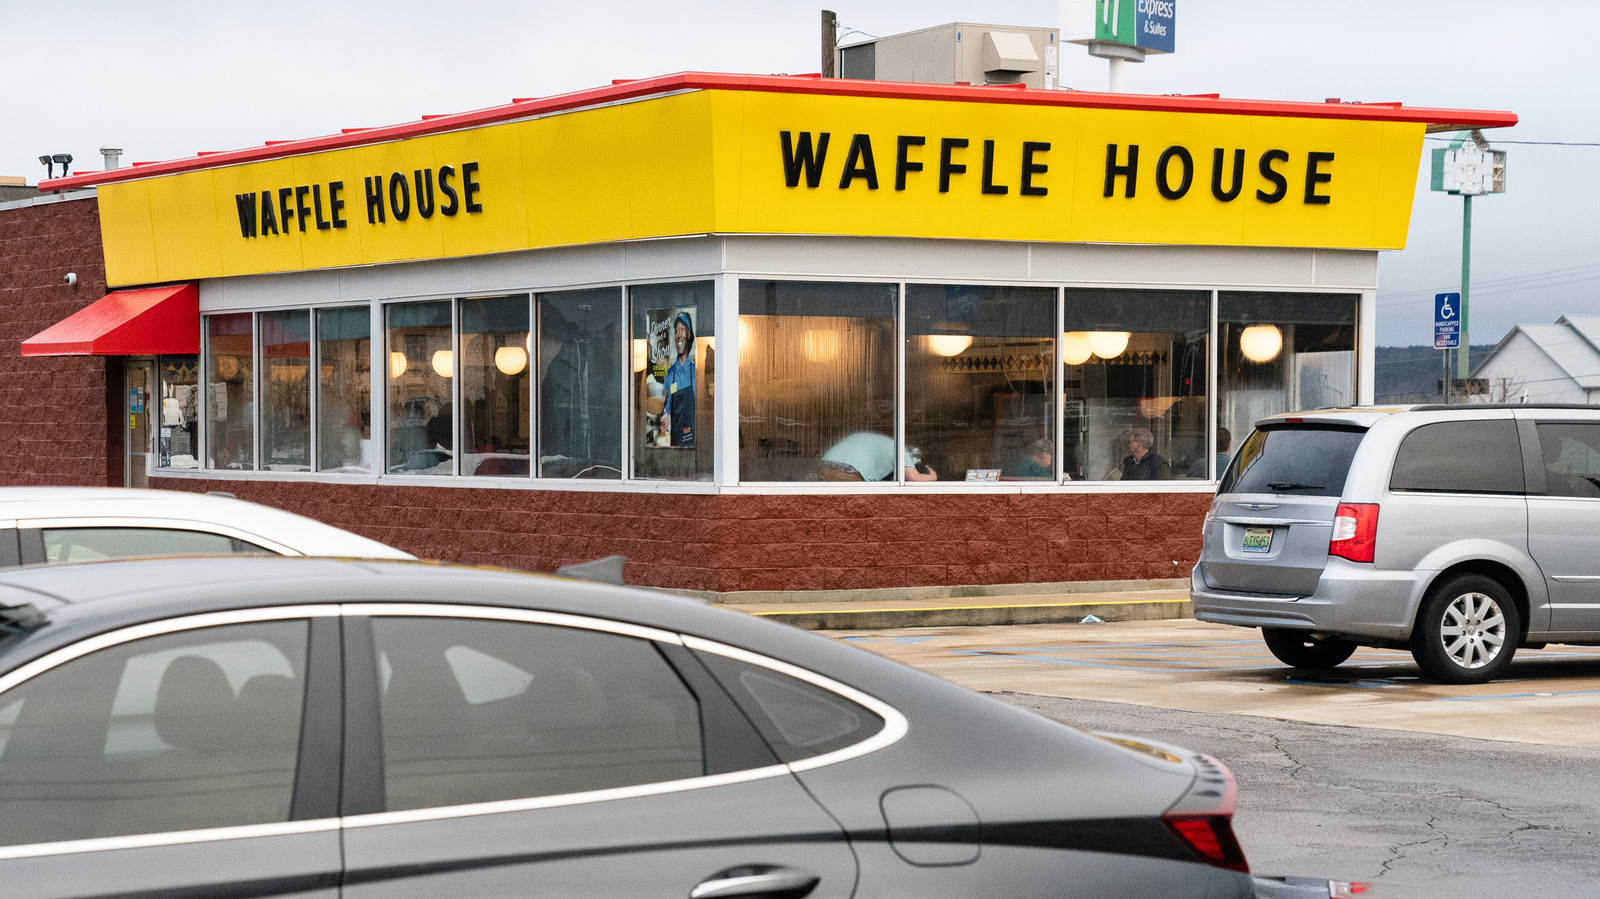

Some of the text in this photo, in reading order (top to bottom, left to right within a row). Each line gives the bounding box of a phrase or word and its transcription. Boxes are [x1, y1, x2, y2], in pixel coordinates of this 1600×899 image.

[1139, 0, 1173, 19] Express
[1144, 20, 1166, 36] & Suites
[780, 130, 1335, 205] WAFFLE HOUSE
[235, 162, 483, 239] WAFFLE HOUSE
